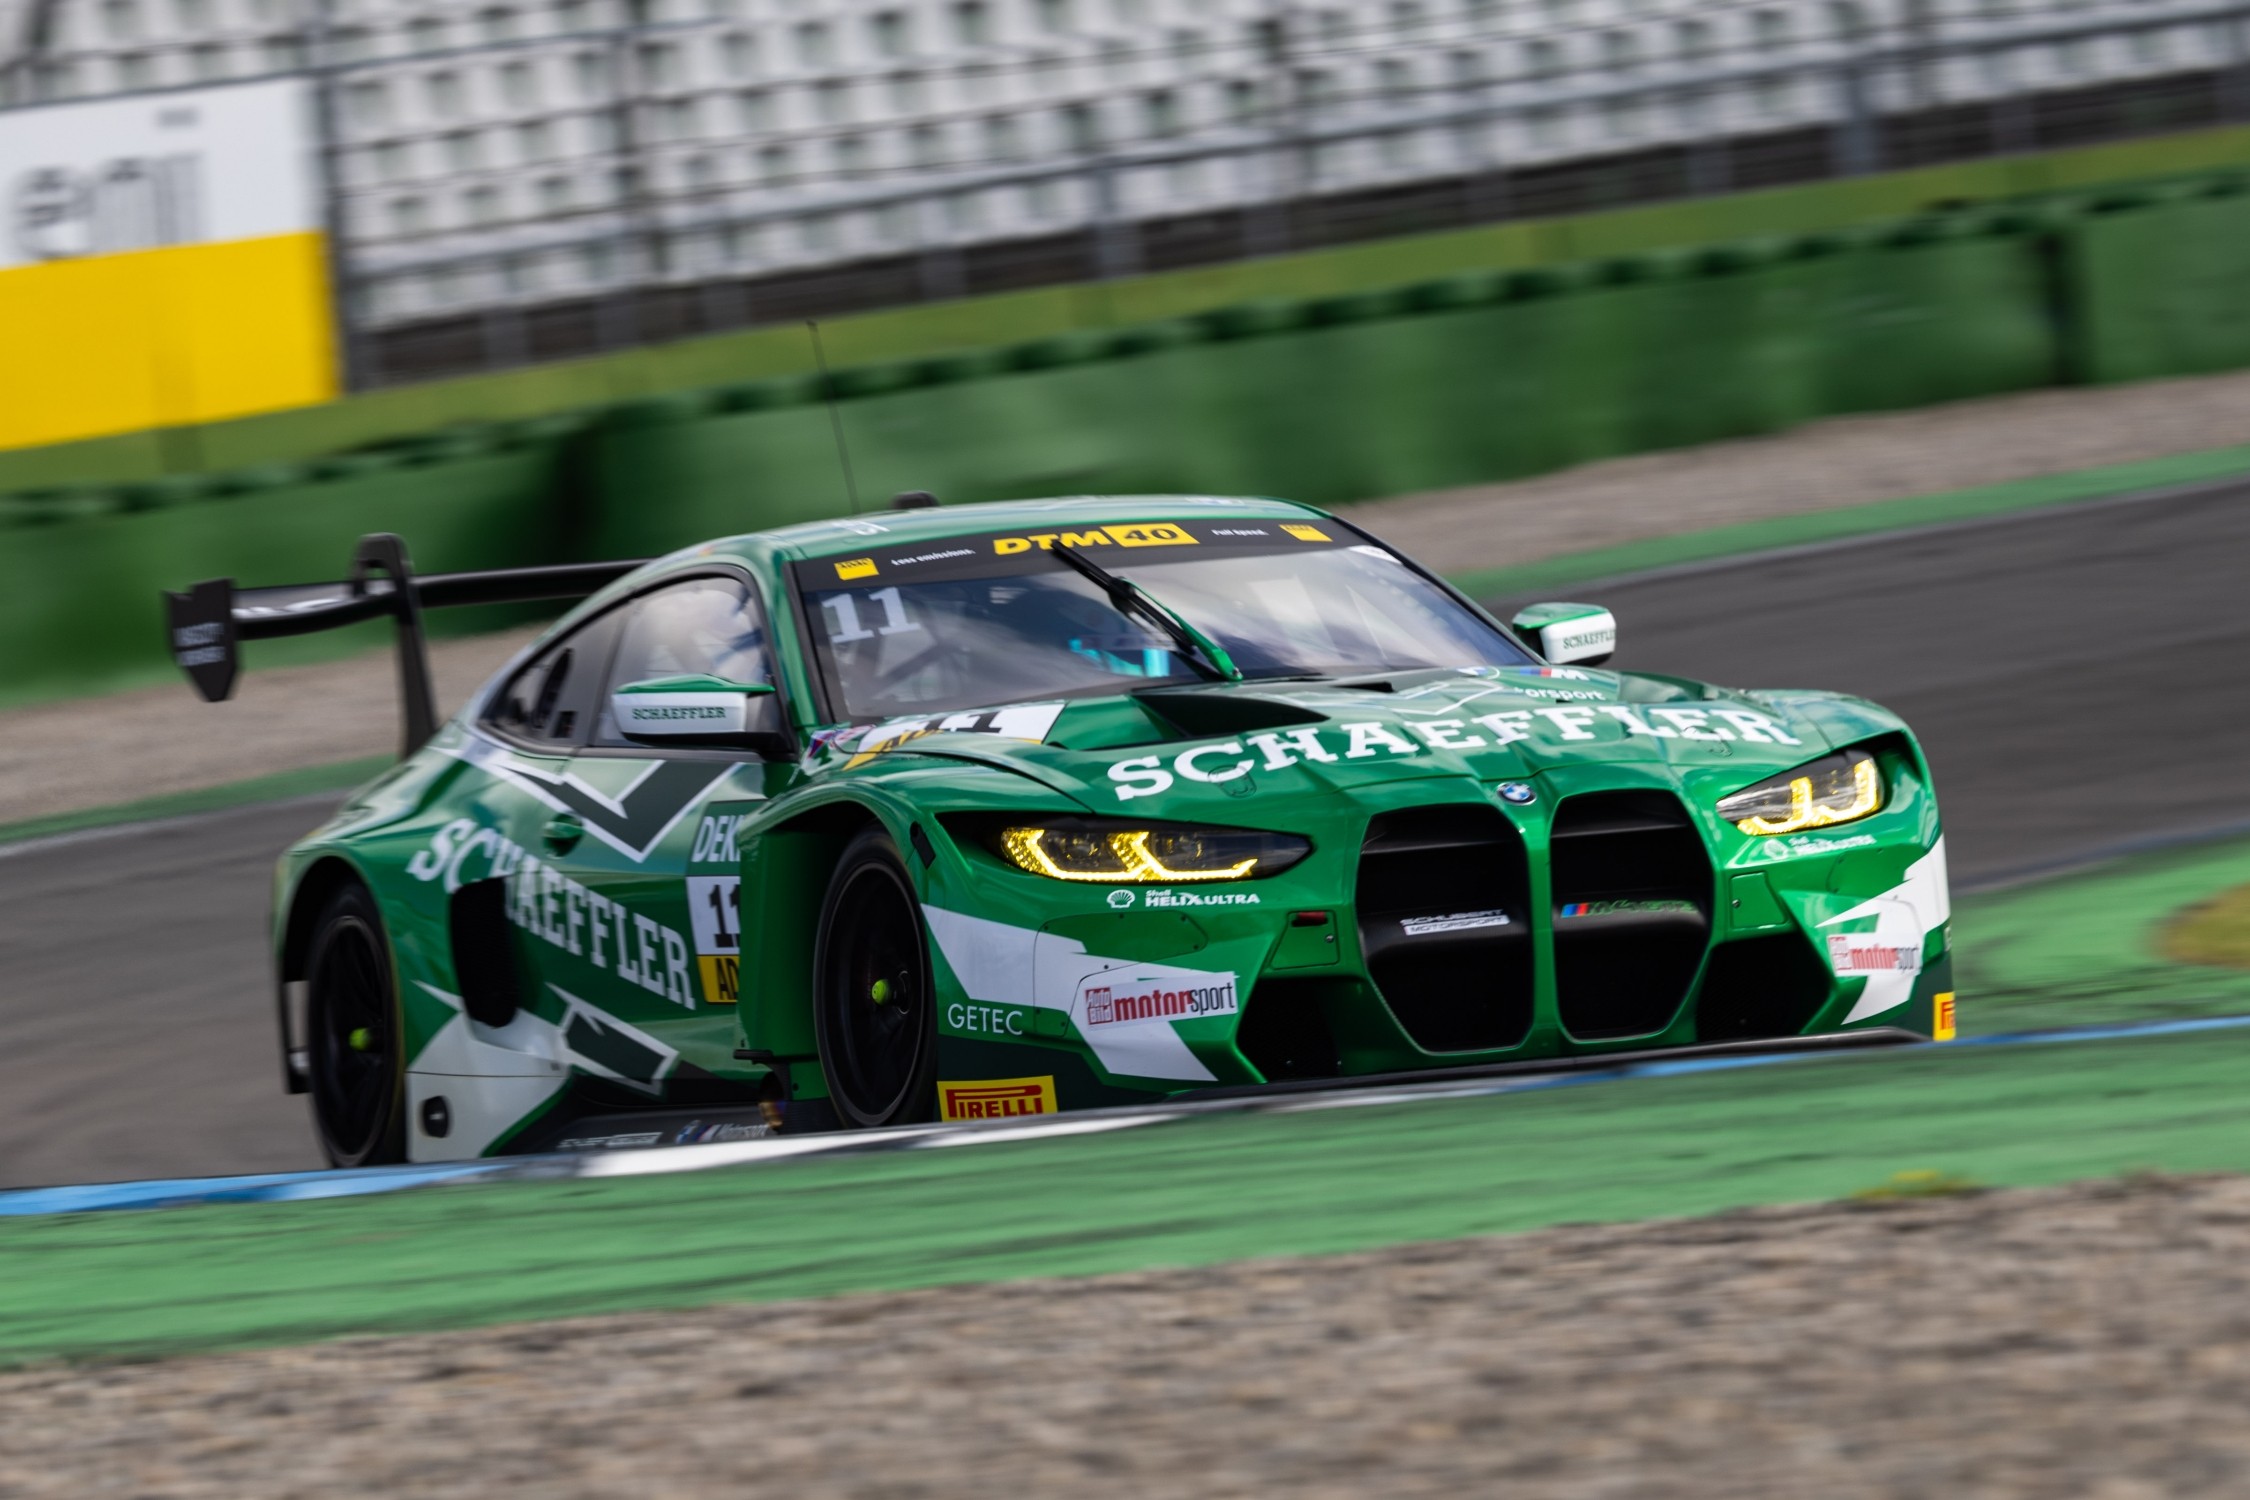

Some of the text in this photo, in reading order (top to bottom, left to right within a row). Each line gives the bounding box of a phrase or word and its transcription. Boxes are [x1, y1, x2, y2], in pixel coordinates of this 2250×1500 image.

[993, 528, 1179, 556] DTM 40
[822, 587, 921, 643] 11
[631, 706, 726, 720] SCHAEFFLER
[1107, 704, 1802, 801] SCHAEFFLER
[691, 815, 742, 862] DEK
[404, 818, 696, 1010] SCHAEFFLER
[1145, 892, 1261, 908] HELIX ULTRA
[947, 1003, 1023, 1036] GETEC
[945, 1084, 1043, 1118] PIRELLI
